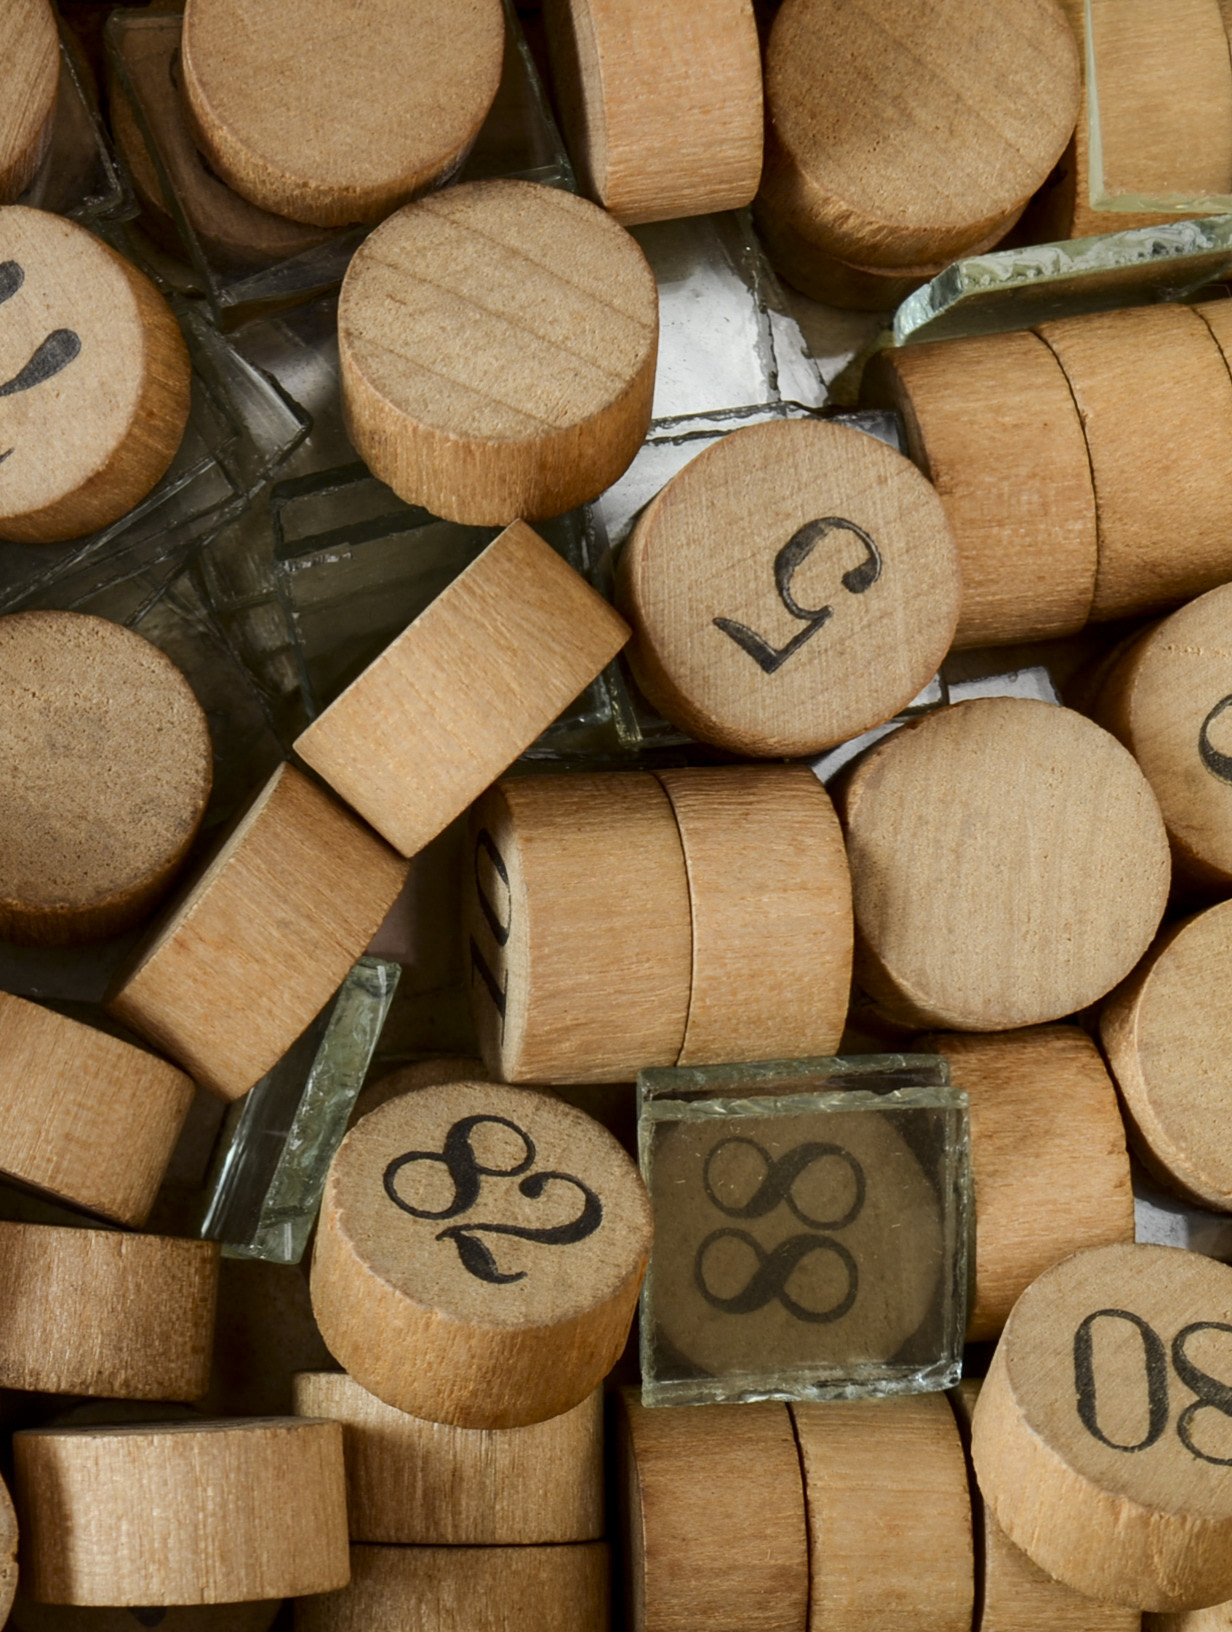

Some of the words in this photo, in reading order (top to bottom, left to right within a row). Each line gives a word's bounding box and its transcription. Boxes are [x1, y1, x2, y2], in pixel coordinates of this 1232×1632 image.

[712, 517, 883, 675] 5
[469, 827, 511, 1046] 10
[383, 1114, 602, 1284] 82
[694, 1136, 866, 1323] 88
